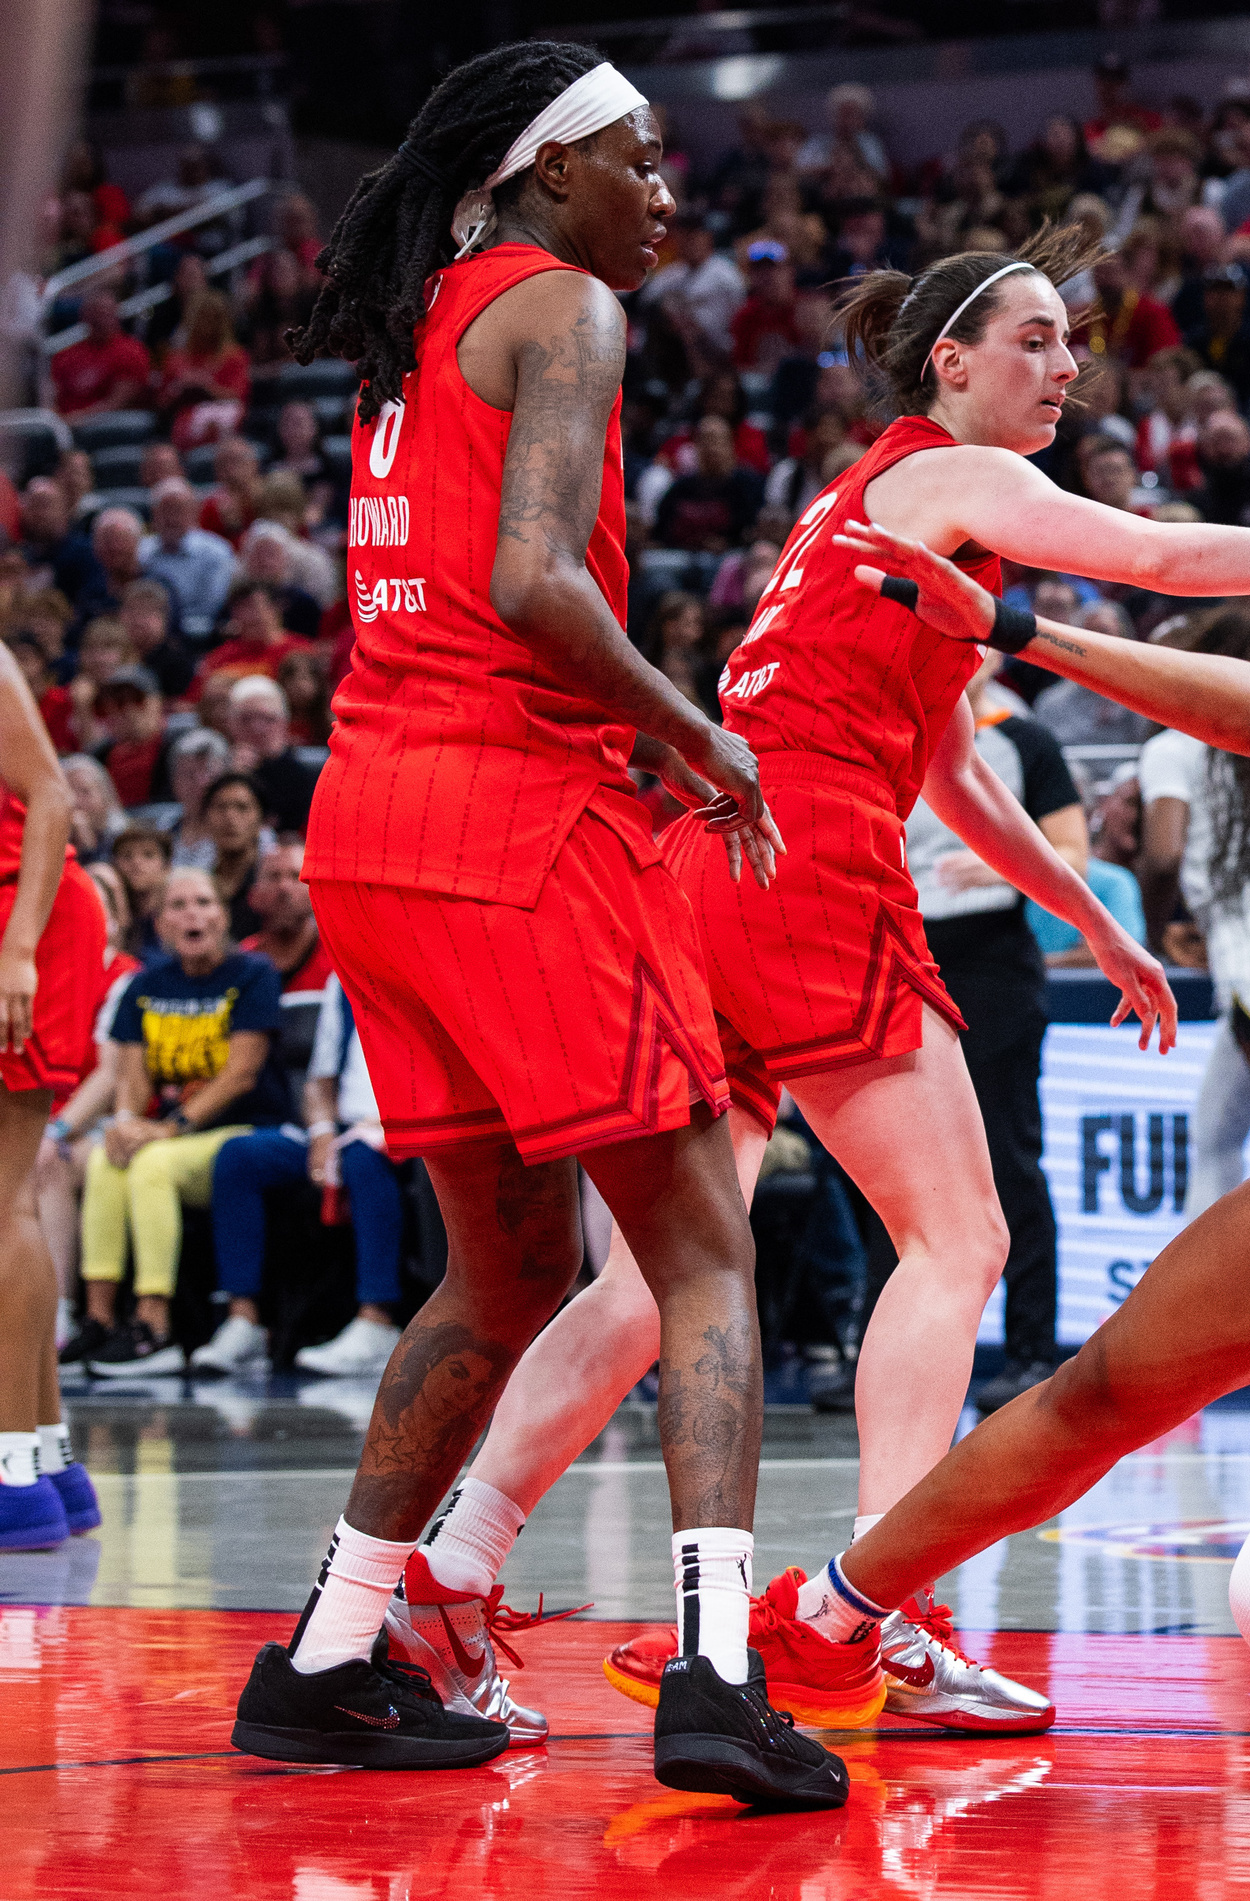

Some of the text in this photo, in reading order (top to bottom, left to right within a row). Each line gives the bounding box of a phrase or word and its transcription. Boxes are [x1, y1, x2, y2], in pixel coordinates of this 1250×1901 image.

[349, 495, 410, 548] HOWARD
[371, 577, 428, 614] AT&T
[723, 661, 781, 699] AT&T
[524, 918, 541, 961] CHOSE
